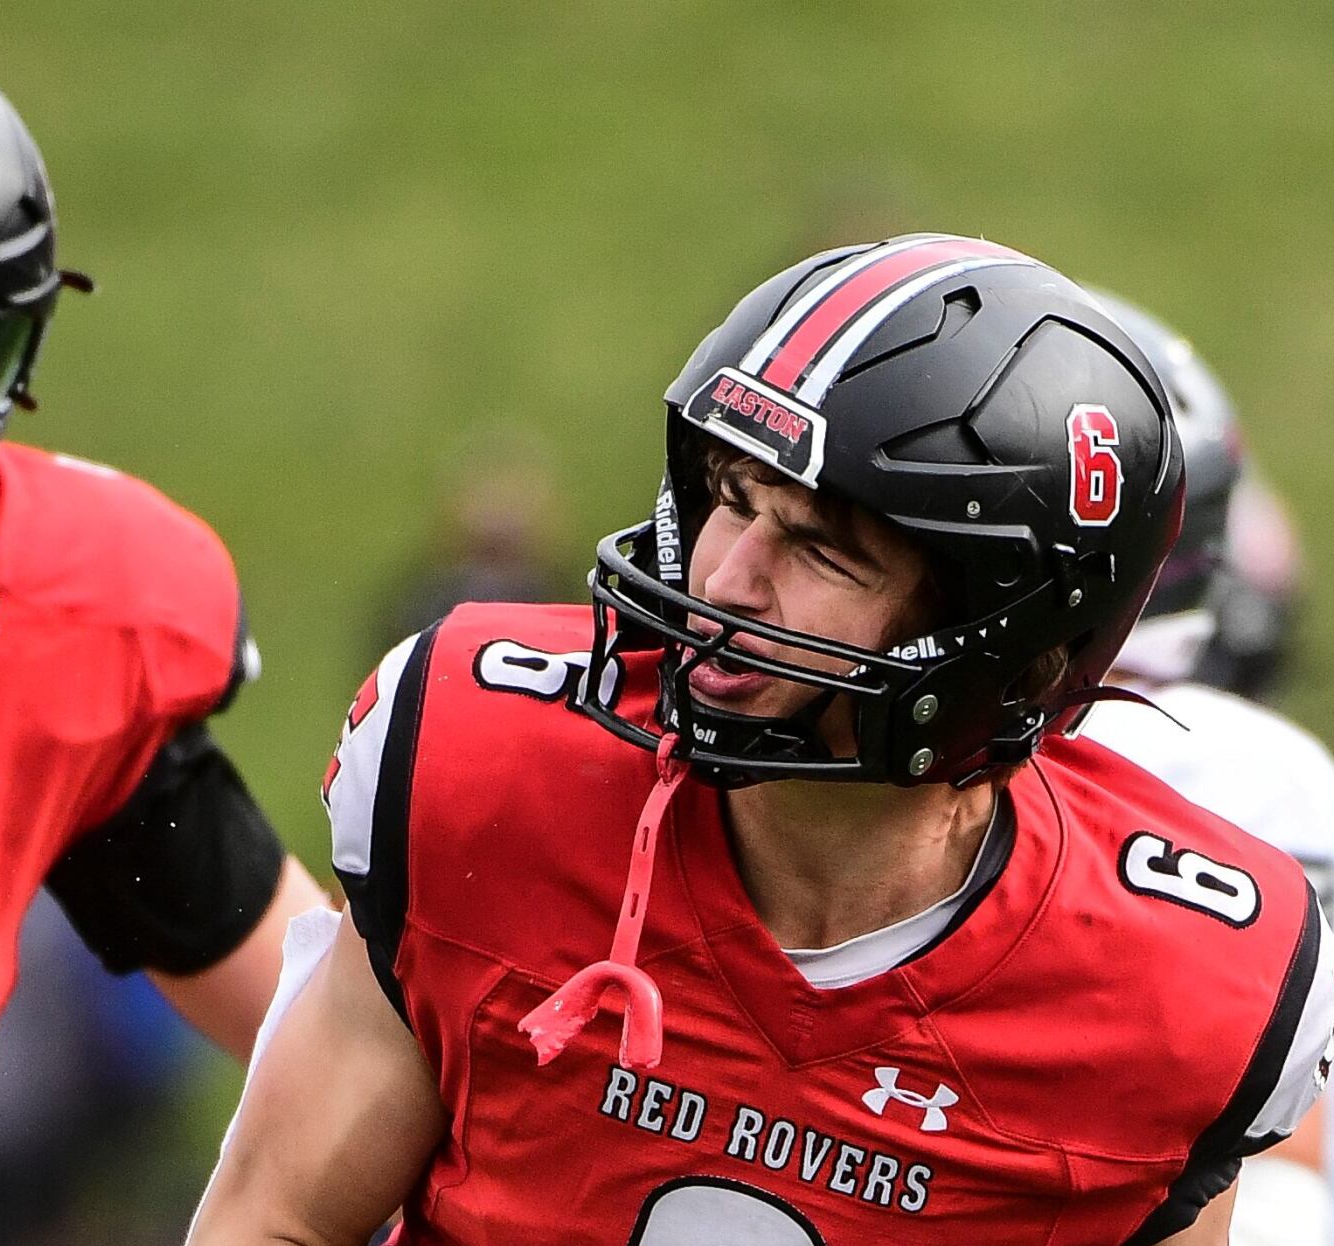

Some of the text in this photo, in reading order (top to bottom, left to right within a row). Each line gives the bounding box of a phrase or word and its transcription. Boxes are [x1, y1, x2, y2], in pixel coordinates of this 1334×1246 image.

[711, 376, 808, 443] EASTON
[1067, 402, 1123, 527] 6
[655, 490, 682, 581] Riddell
[471, 638, 627, 712] 6
[1118, 831, 1261, 929] 6
[601, 1066, 931, 1214] RED ROVERS
